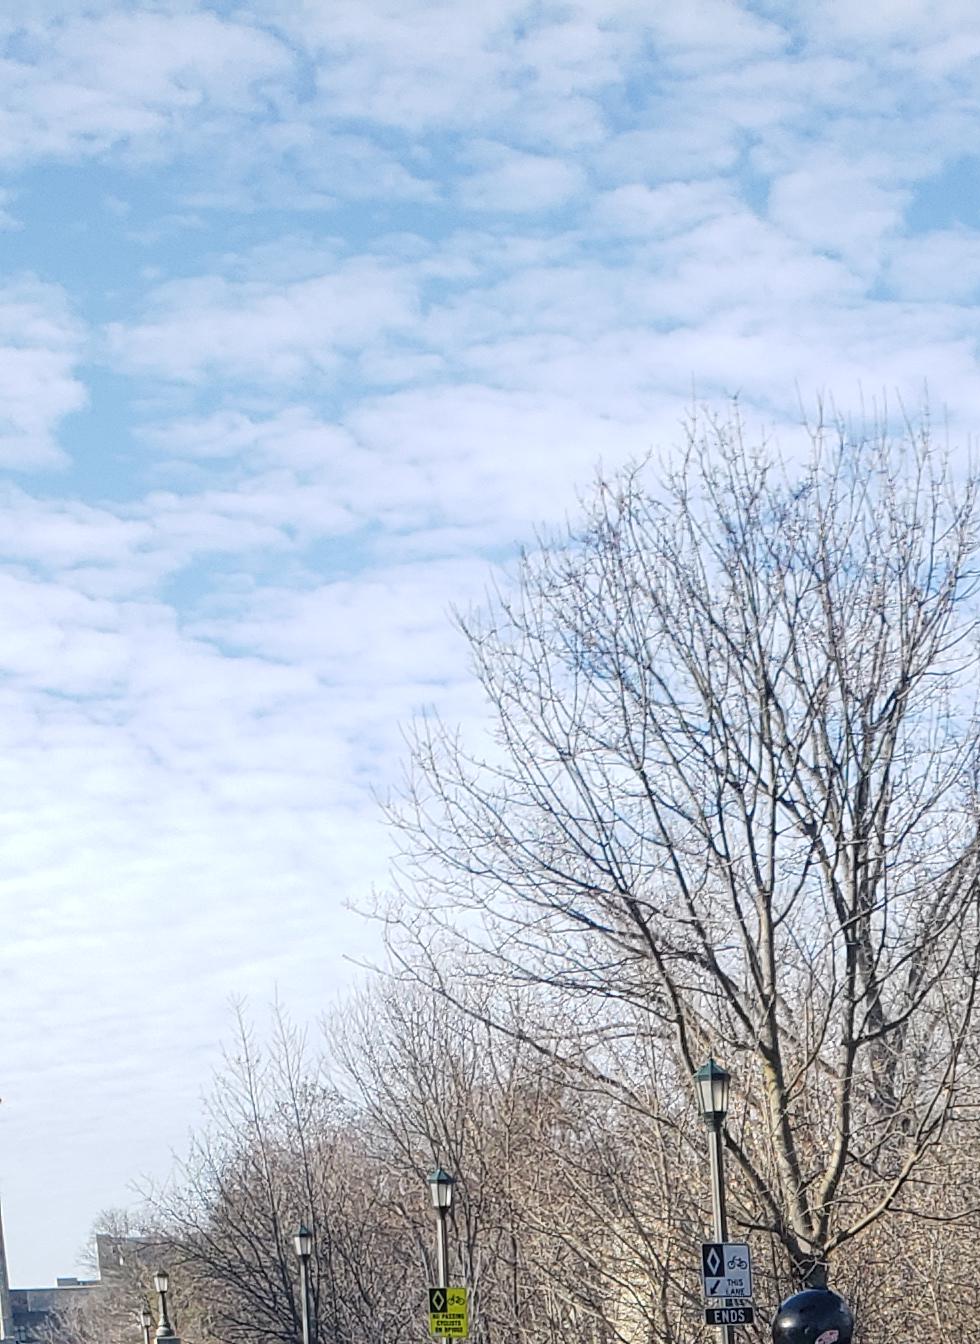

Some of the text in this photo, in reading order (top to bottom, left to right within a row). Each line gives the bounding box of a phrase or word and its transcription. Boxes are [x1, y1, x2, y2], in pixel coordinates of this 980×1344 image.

[726, 1278, 744, 1286] THIS
[725, 1288, 745, 1296] LANE
[713, 1309, 746, 1323] ENDS
